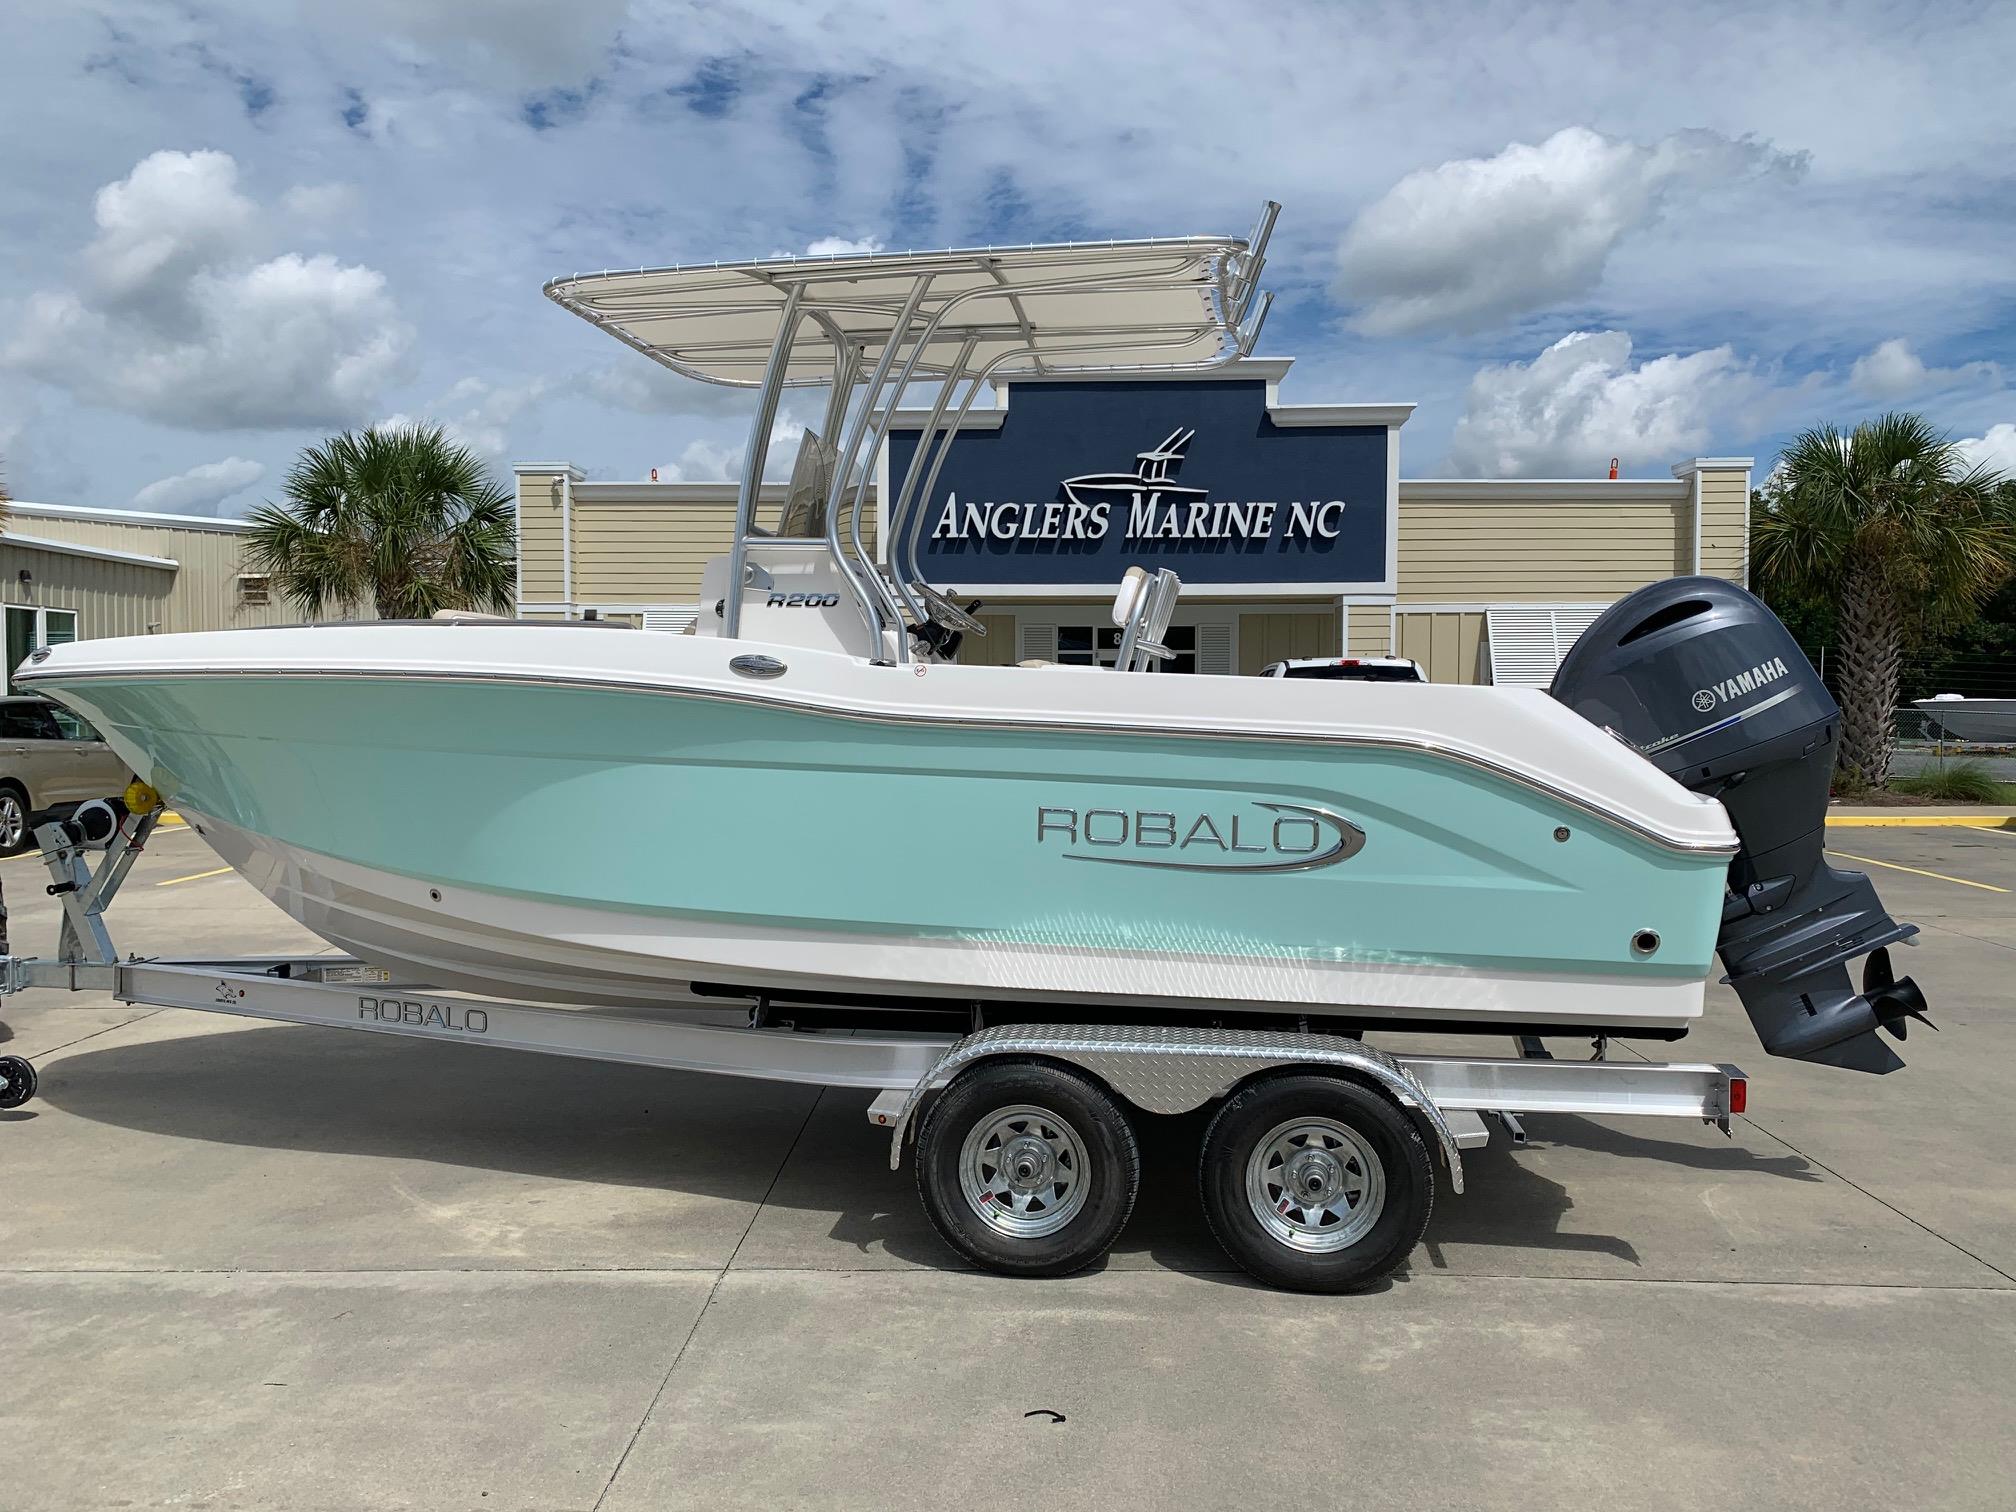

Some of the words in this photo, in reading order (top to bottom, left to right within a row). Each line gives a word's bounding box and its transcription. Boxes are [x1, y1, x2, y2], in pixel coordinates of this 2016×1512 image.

[931, 492, 1111, 539] ANGLERS
[1125, 492, 1277, 538] MARINE
[1284, 500, 1346, 539] NC
[766, 592, 841, 609] R200
[1713, 657, 1789, 704] YAMAHA
[1037, 806, 1320, 852] ROBALO
[358, 996, 488, 1034] ROBALO
